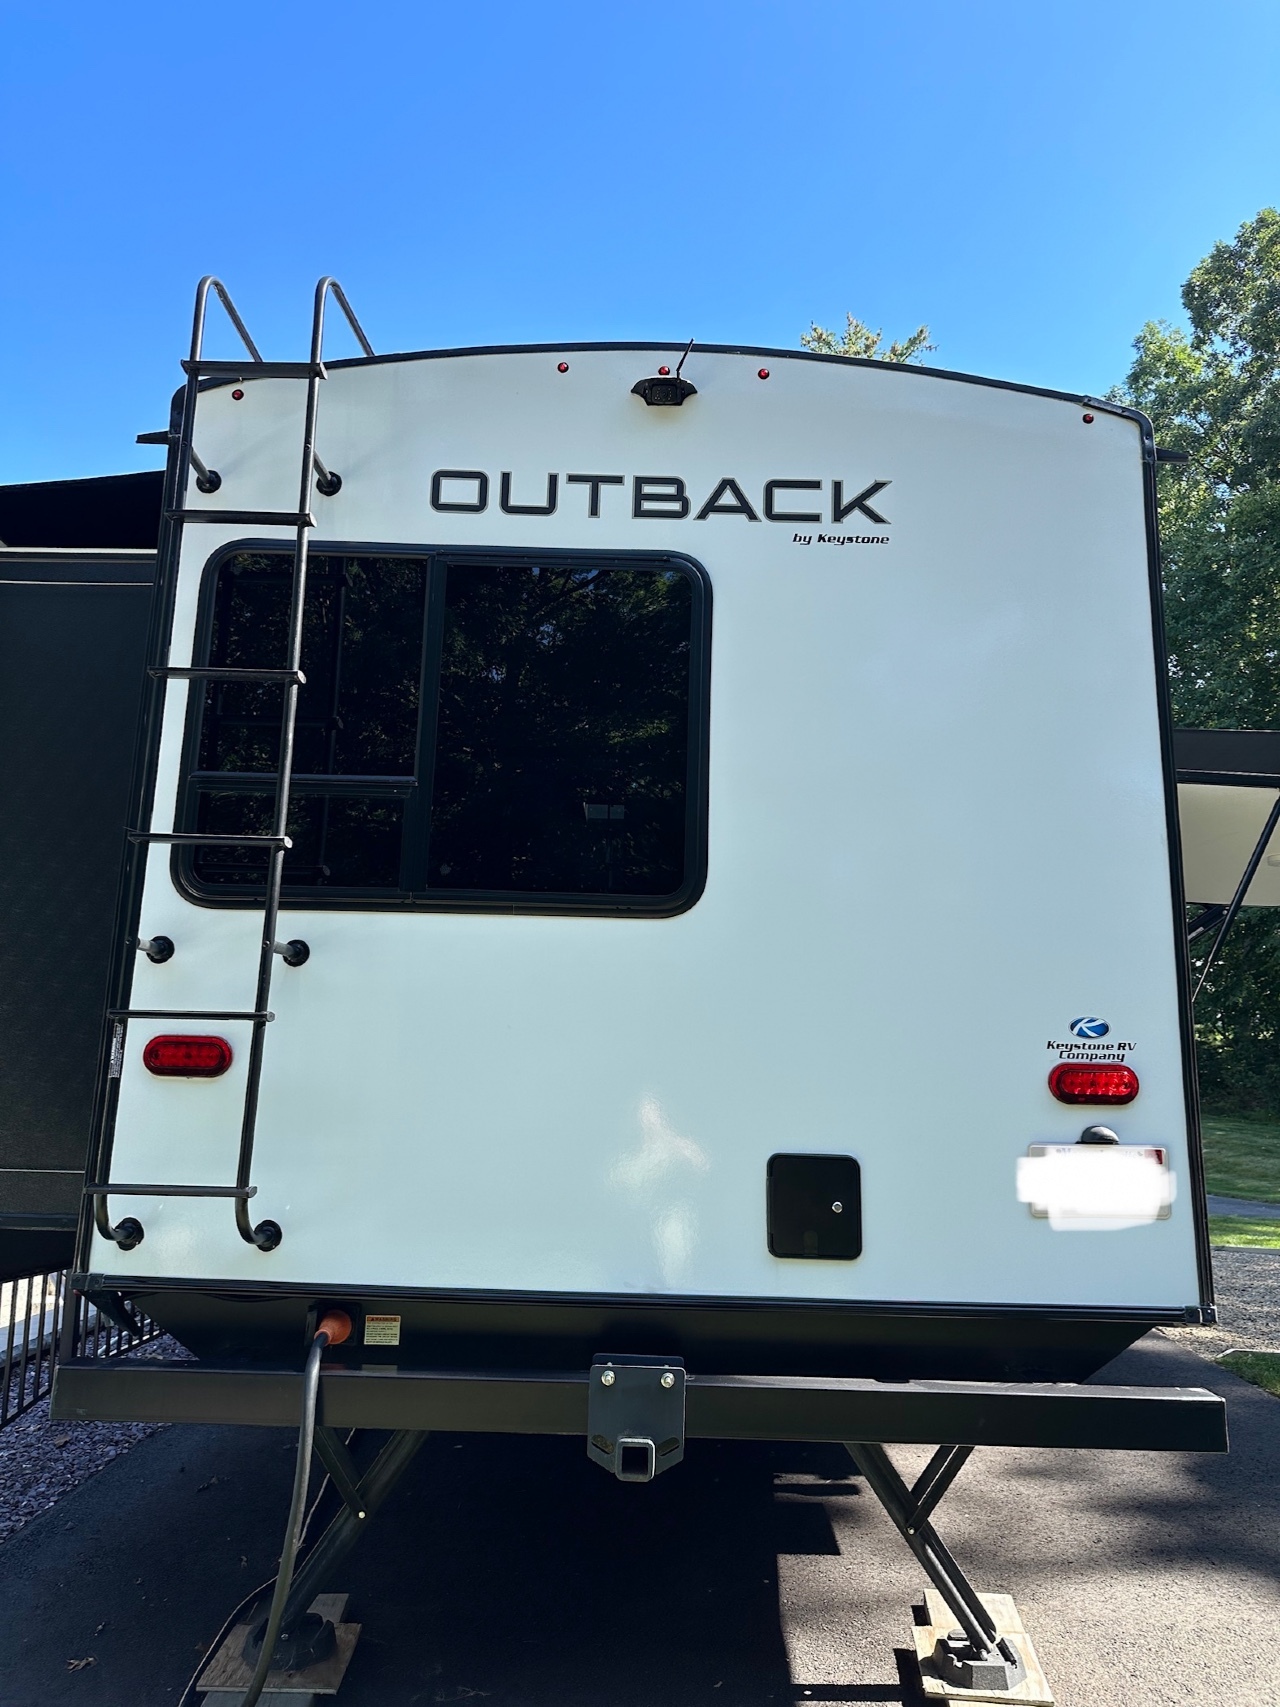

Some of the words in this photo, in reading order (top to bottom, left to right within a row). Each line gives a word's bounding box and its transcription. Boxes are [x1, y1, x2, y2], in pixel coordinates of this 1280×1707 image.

[429, 468, 893, 525] OUTBACK
[792, 533, 812, 545] by
[817, 533, 890, 545] Keystone
[1046, 1040, 1114, 1052] Keystone
[1117, 1042, 1137, 1051] RV
[1059, 1050, 1125, 1062] Company
